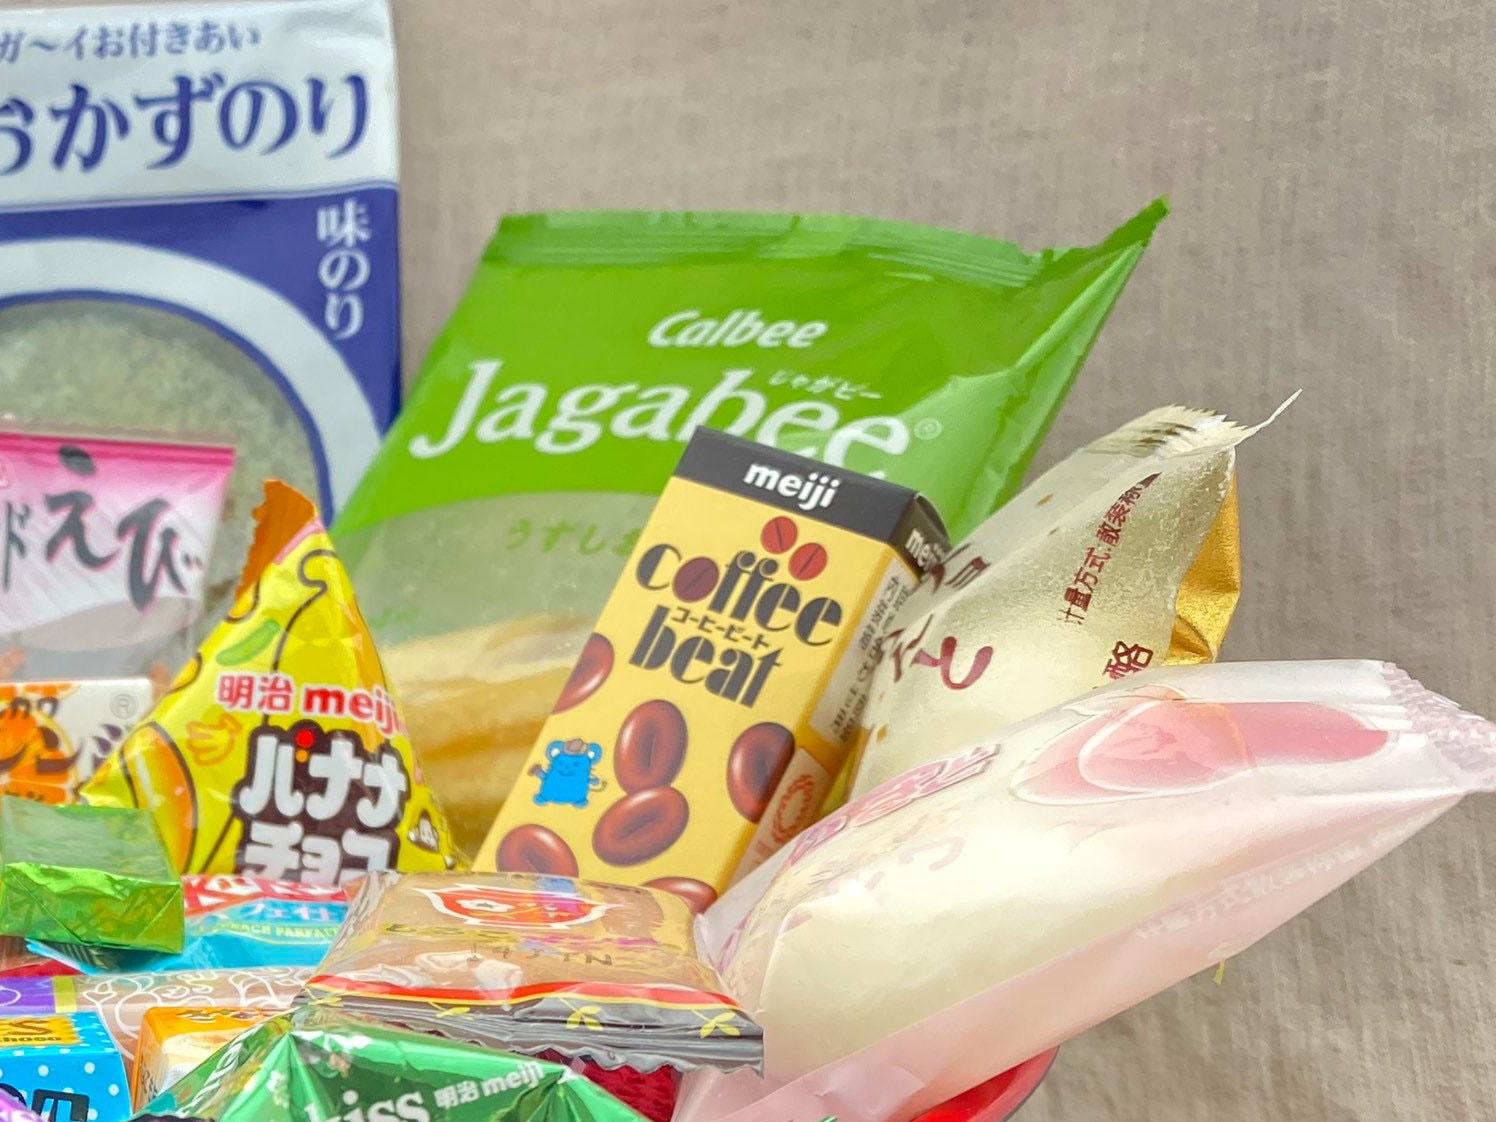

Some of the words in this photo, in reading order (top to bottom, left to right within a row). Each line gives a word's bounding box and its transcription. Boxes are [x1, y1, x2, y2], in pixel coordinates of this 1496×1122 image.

[316, 199, 373, 340] 味のり
[647, 309, 829, 349] Calbee
[768, 368, 883, 401] じゃがビー
[409, 359, 910, 480] Jagabee
[743, 462, 840, 512] meiji
[629, 605, 784, 709] beat
[218, 674, 293, 712] 明治
[303, 685, 408, 737] meiji
[239, 727, 409, 829] バナナ
[244, 820, 394, 885] チョコ
[434, 1080, 479, 1109] 明治
[481, 1061, 545, 1097] meiji
